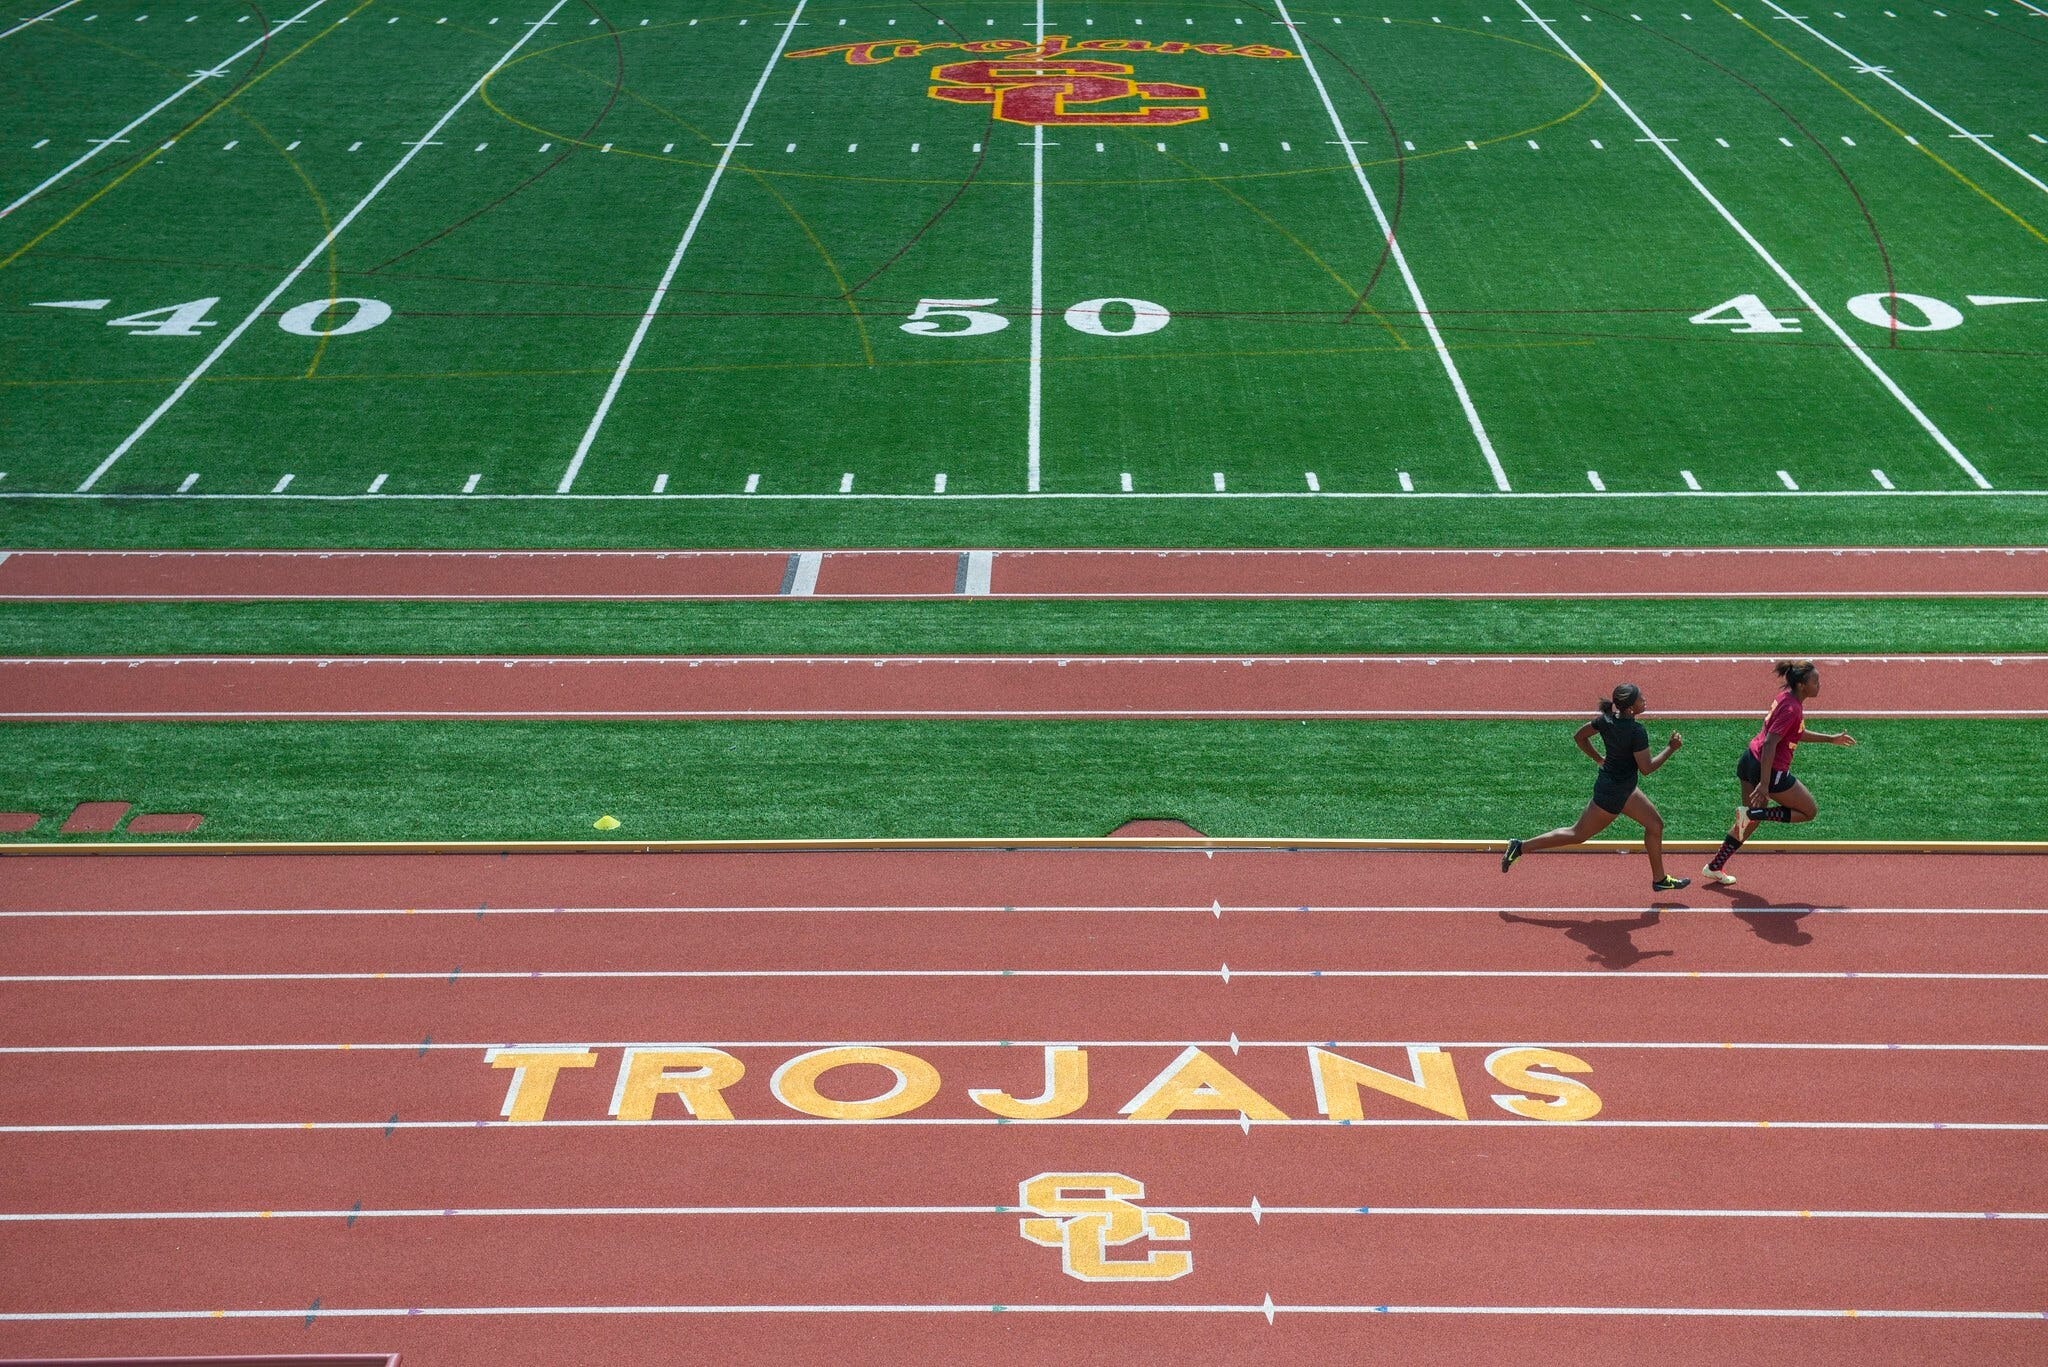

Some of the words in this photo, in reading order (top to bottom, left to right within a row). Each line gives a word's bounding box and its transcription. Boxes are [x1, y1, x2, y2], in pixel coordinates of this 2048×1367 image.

[784, 35, 1303, 65] Trojans
[928, 60, 1209, 126] SC
[483, 1046, 1603, 1121] TROJANS
[1019, 1172, 1194, 1282] SC
